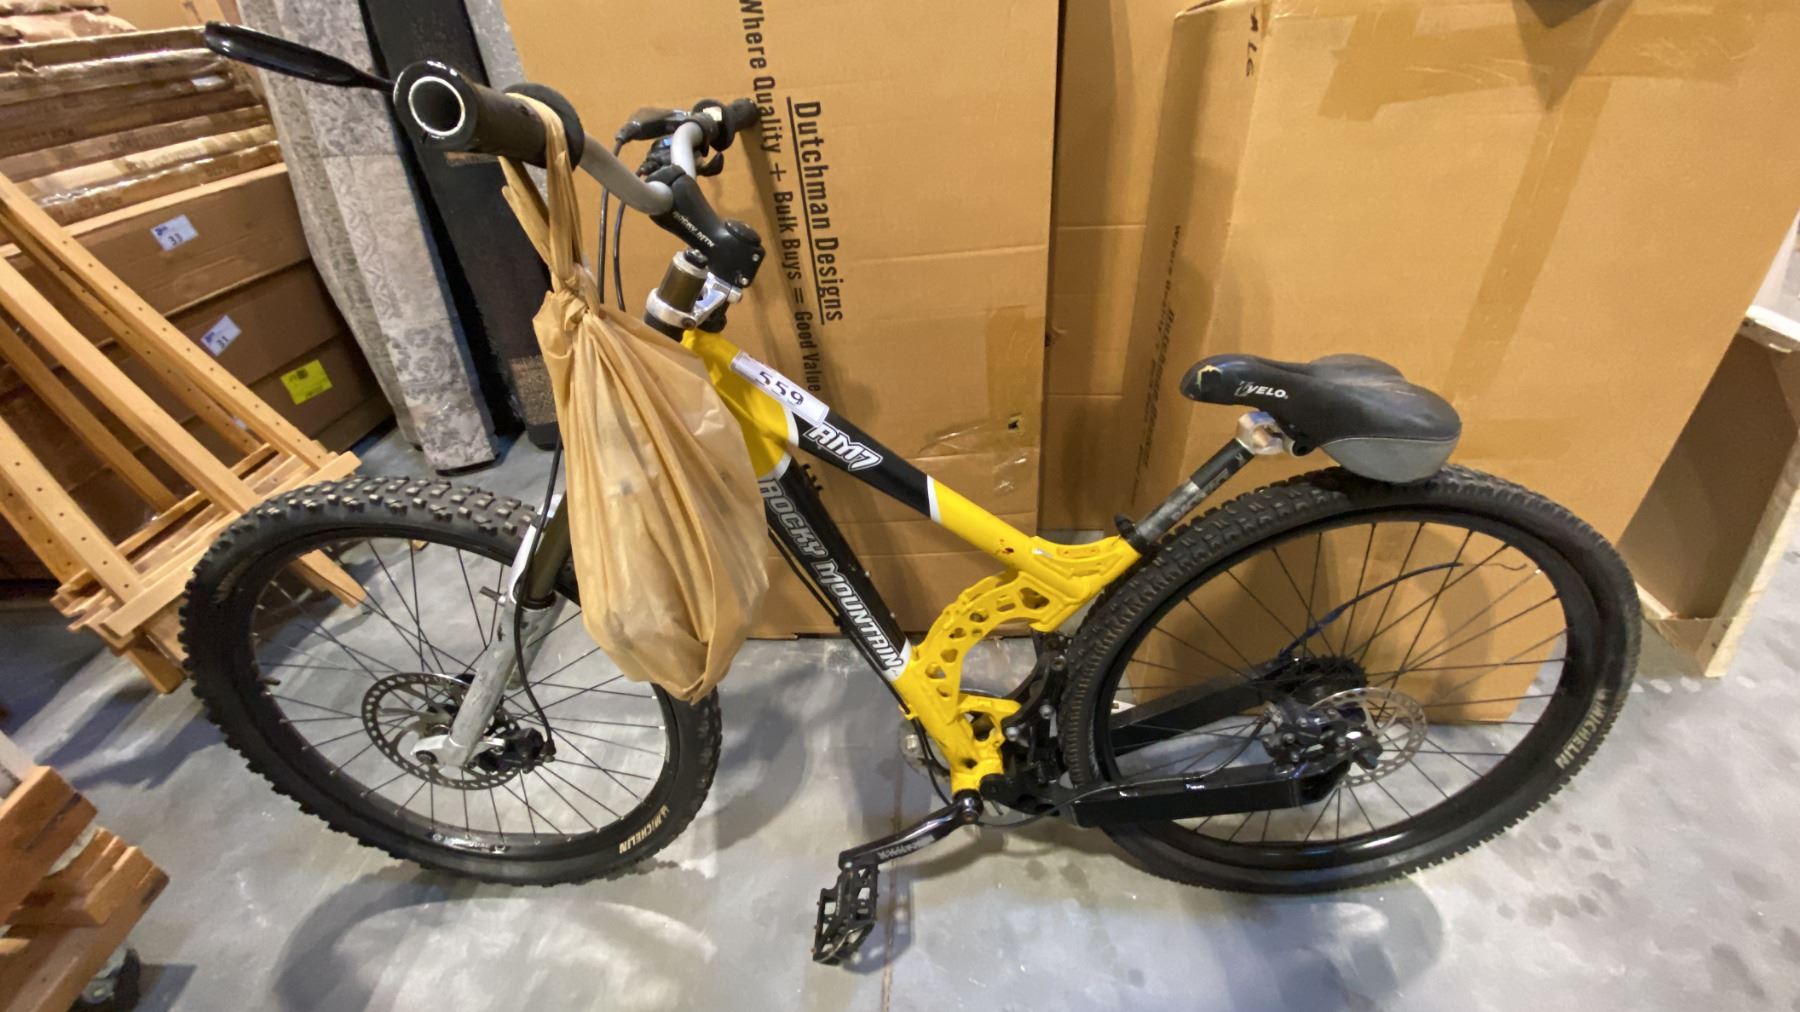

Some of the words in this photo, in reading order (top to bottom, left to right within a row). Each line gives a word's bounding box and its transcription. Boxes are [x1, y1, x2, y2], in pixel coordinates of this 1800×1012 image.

[739, 0, 767, 69] Where
[753, 76, 782, 153] Quality
[773, 191, 798, 233] Bulk
[794, 101, 831, 230] Dutchman
[815, 237, 844, 321] Designs
[781, 238, 802, 280] Buys
[795, 311, 817, 349] Good
[758, 371, 804, 405] 559
[802, 352, 822, 392] Value
[1247, 384, 1287, 399] VELO
[804, 423, 882, 470] RM7
[758, 479, 828, 558] ROCKY
[813, 559, 905, 672] MOUNTAIN
[1555, 700, 1606, 769] MICHELIN
[619, 813, 662, 854] MICHELIN
